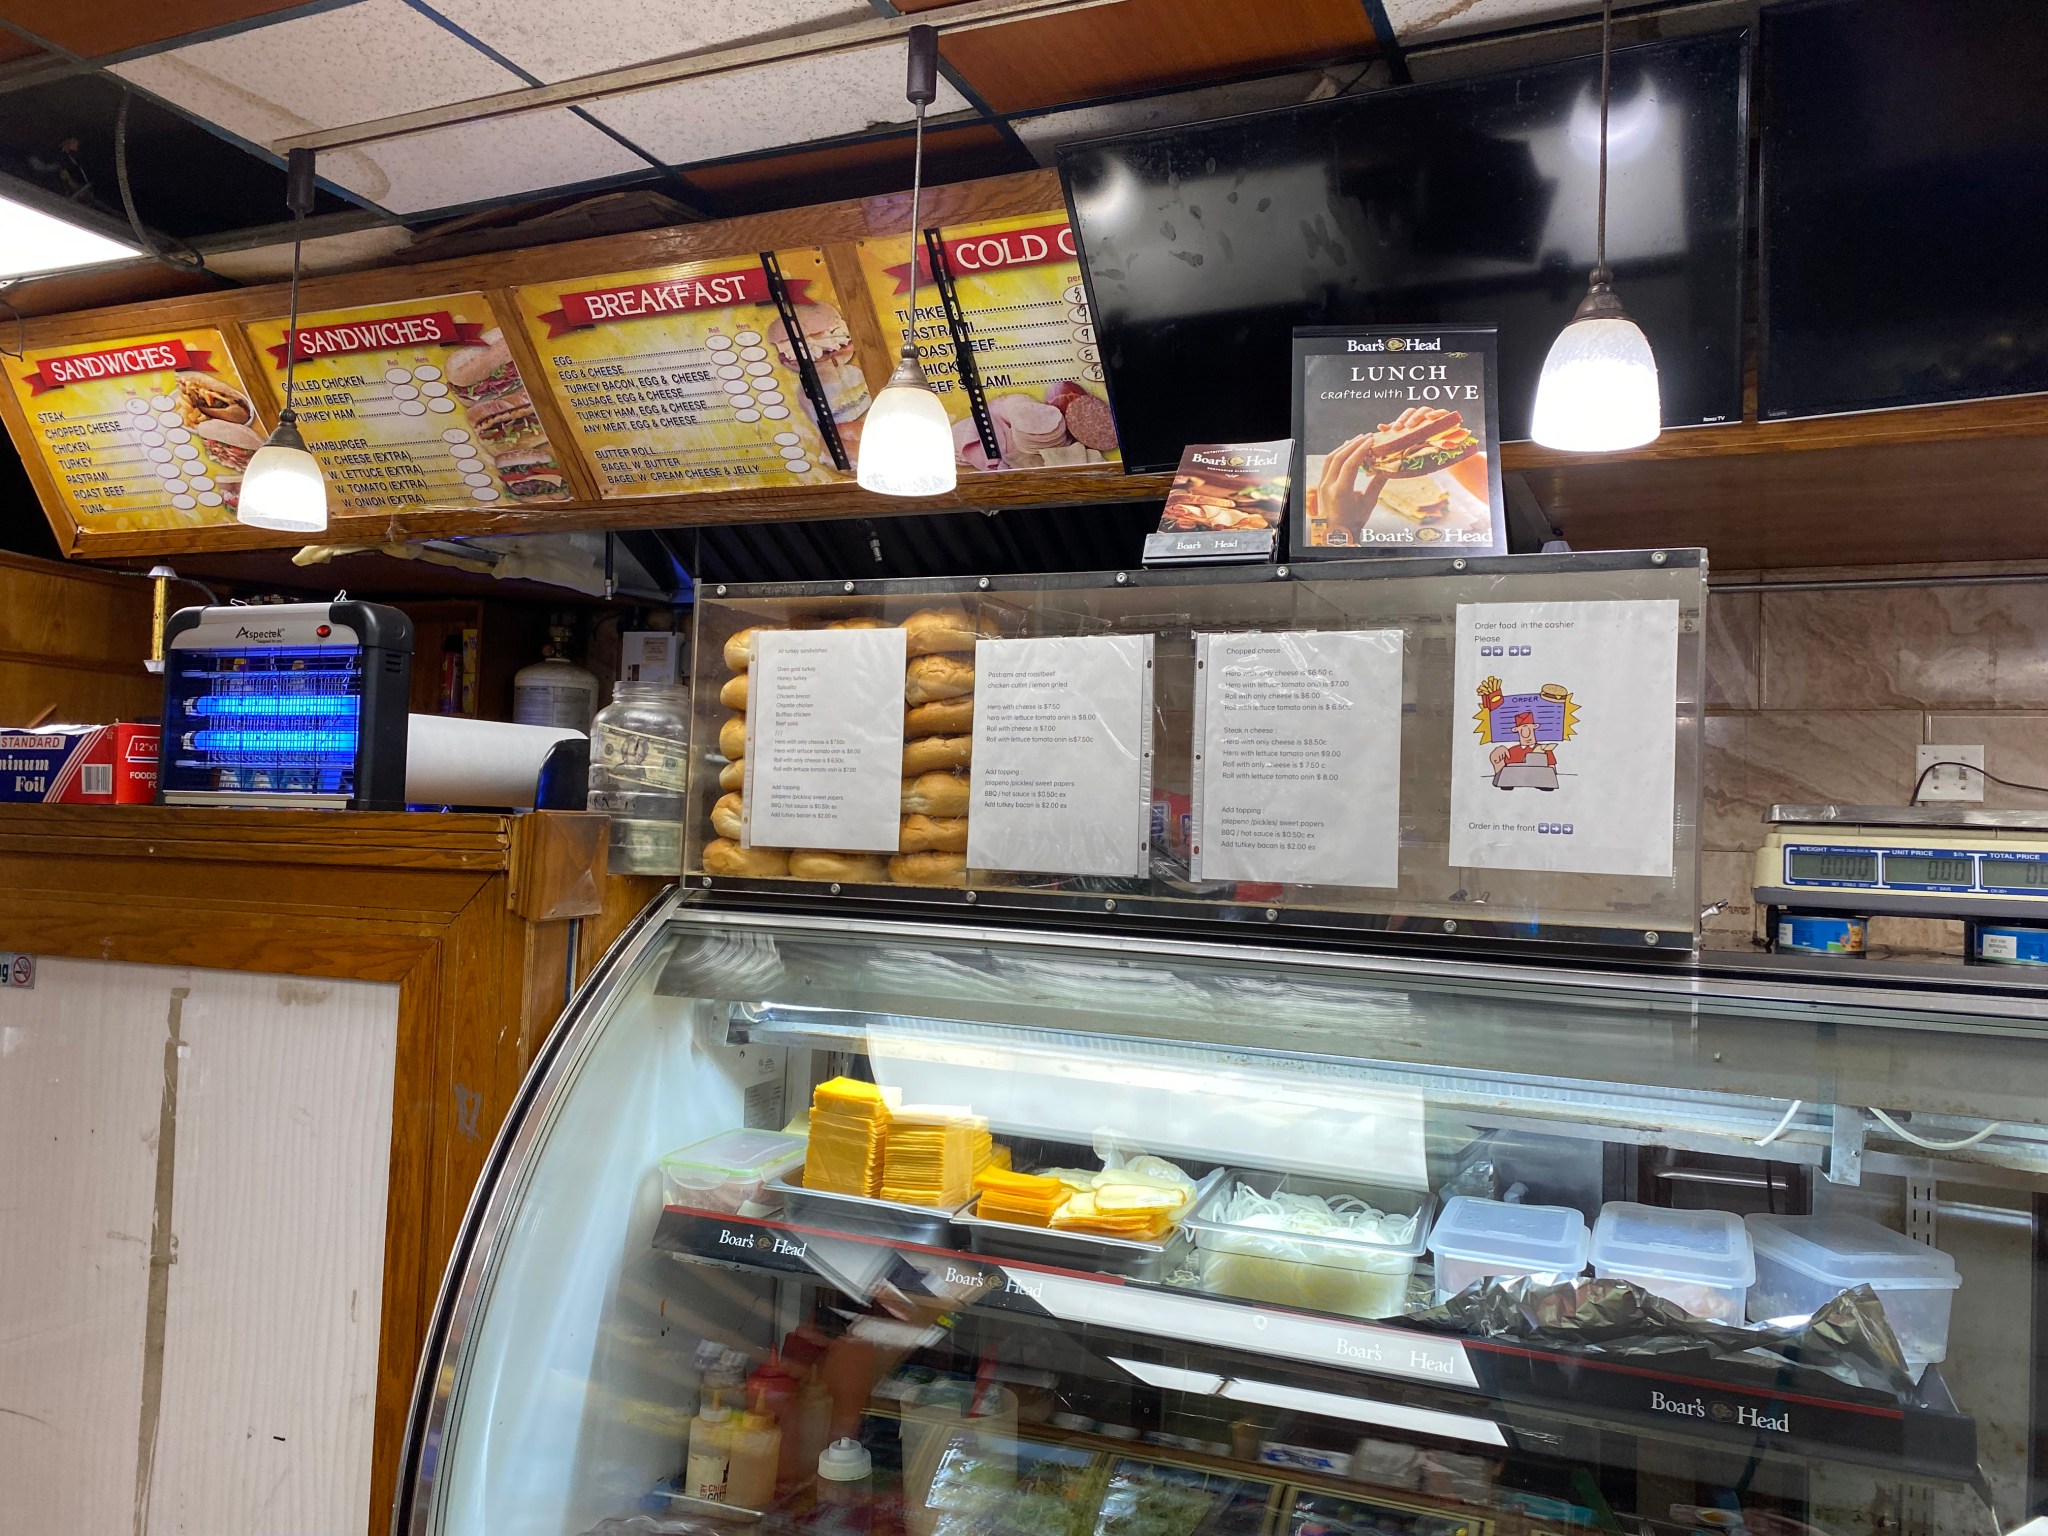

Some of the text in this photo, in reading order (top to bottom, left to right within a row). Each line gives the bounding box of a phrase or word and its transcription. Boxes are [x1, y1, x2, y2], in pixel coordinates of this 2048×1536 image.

[956, 235, 1048, 269] COLD
[585, 276, 746, 319] BREAKFAST
[895, 306, 944, 322] TURKE
[299, 318, 441, 354] SANDWICHES
[919, 339, 995, 357] OAST EEF
[1347, 338, 1441, 352] Boar's Head
[51, 345, 176, 382] SANDWICHES
[553, 356, 573, 366] EGG
[558, 365, 624, 380] EGG & CHEESE
[1351, 366, 1447, 382] LUNCH
[322, 376, 365, 389] CHICKEN
[564, 371, 711, 393] TURKEY BACON, EGG & CHEESE
[929, 380, 954, 392] EEF
[324, 393, 355, 406] (BEEF)
[617, 392, 636, 403] EGG
[638, 392, 644, 400] &
[646, 388, 684, 400] CHEESE
[1407, 385, 1479, 400] LOVE
[296, 409, 355, 422] TURKEY HAM
[576, 400, 707, 420] TURKEY HAM, EGG & CHEESE
[38, 412, 65, 423] STEAK
[583, 424, 601, 433] ANY
[631, 419, 650, 430] EGG
[652, 418, 658, 427] &
[660, 416, 697, 426] CHEESE
[45, 422, 121, 440] CHOPPED CHEESE
[52, 441, 90, 454] CHICKEN
[308, 439, 368, 452] HAMBURGER
[334, 454, 372, 464] CHEESE
[373, 451, 412, 463] (EXTRA)
[595, 447, 656, 459] BUTTER ROLL
[1192, 453, 1278, 466] Boar's Head
[59, 457, 92, 469] TURKEY
[601, 462, 631, 472] BAGEL
[644, 458, 680, 468] BUTTER
[66, 472, 110, 484] PASTRAMI
[340, 468, 384, 479] LETTUCE
[385, 465, 424, 476] (EXTRA)
[608, 475, 637, 484] BAGEL
[650, 471, 684, 481] CREAM
[686, 468, 722, 478] CHEESE
[724, 467, 730, 475] &
[732, 464, 759, 474] JELLY
[73, 486, 125, 499] ROAST BEEF
[348, 482, 387, 493] TOMATO
[389, 479, 428, 490] (EXTRA)
[355, 496, 385, 507] ONION
[387, 494, 426, 505] (EXTRA)
[80, 505, 104, 514] TUNA
[1362, 528, 1413, 543] Boar's
[1444, 527, 1493, 542] Head
[1214, 540, 1238, 549] Head
[1545, 621, 1574, 629] cashier
[236, 627, 282, 640] Aspectek
[1475, 635, 1500, 643] Please
[2, 737, 60, 747] STANDARD
[15, 776, 45, 792] Foil
[1517, 824, 1535, 832] front
[719, 1229, 807, 1257] Boar's Head
[945, 1267, 1042, 1298] Boar's Head
[1336, 1338, 1454, 1374] Boar's Head
[1651, 1391, 1790, 1433] Boar's Head
